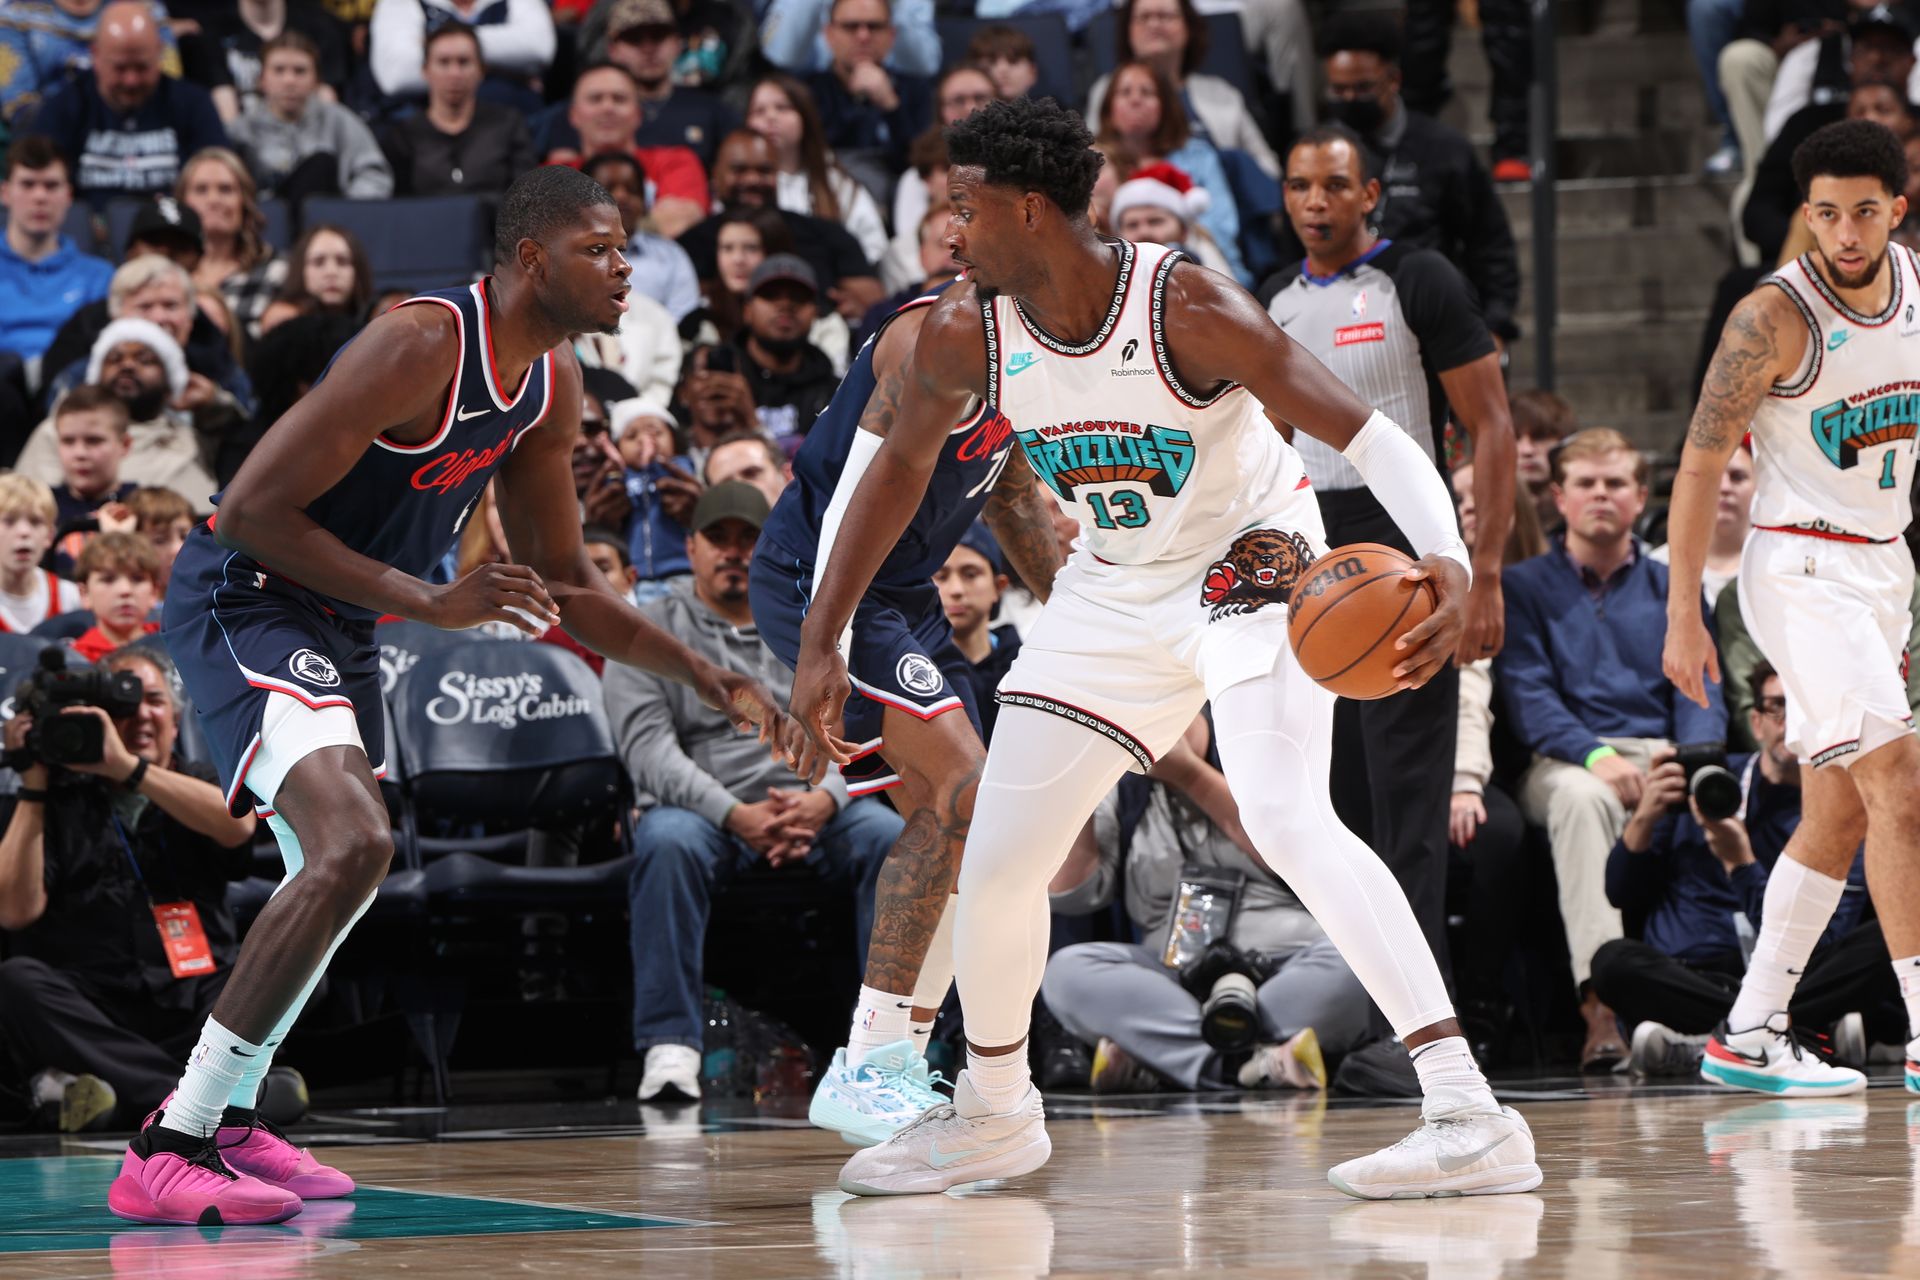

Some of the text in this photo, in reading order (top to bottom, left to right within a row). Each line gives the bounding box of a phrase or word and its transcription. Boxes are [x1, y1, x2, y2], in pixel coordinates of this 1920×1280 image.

[1111, 368, 1156, 378] Robinhood
[1848, 381, 1920, 404] VANCOUVE
[1039, 420, 1143, 438] VANCOUVER
[1016, 423, 1197, 502] GRIZZLIES
[1878, 448, 1896, 490] 1
[1086, 489, 1151, 530] 13
[425, 670, 543, 726] Sissy's
[471, 693, 592, 730] Log Cabin
